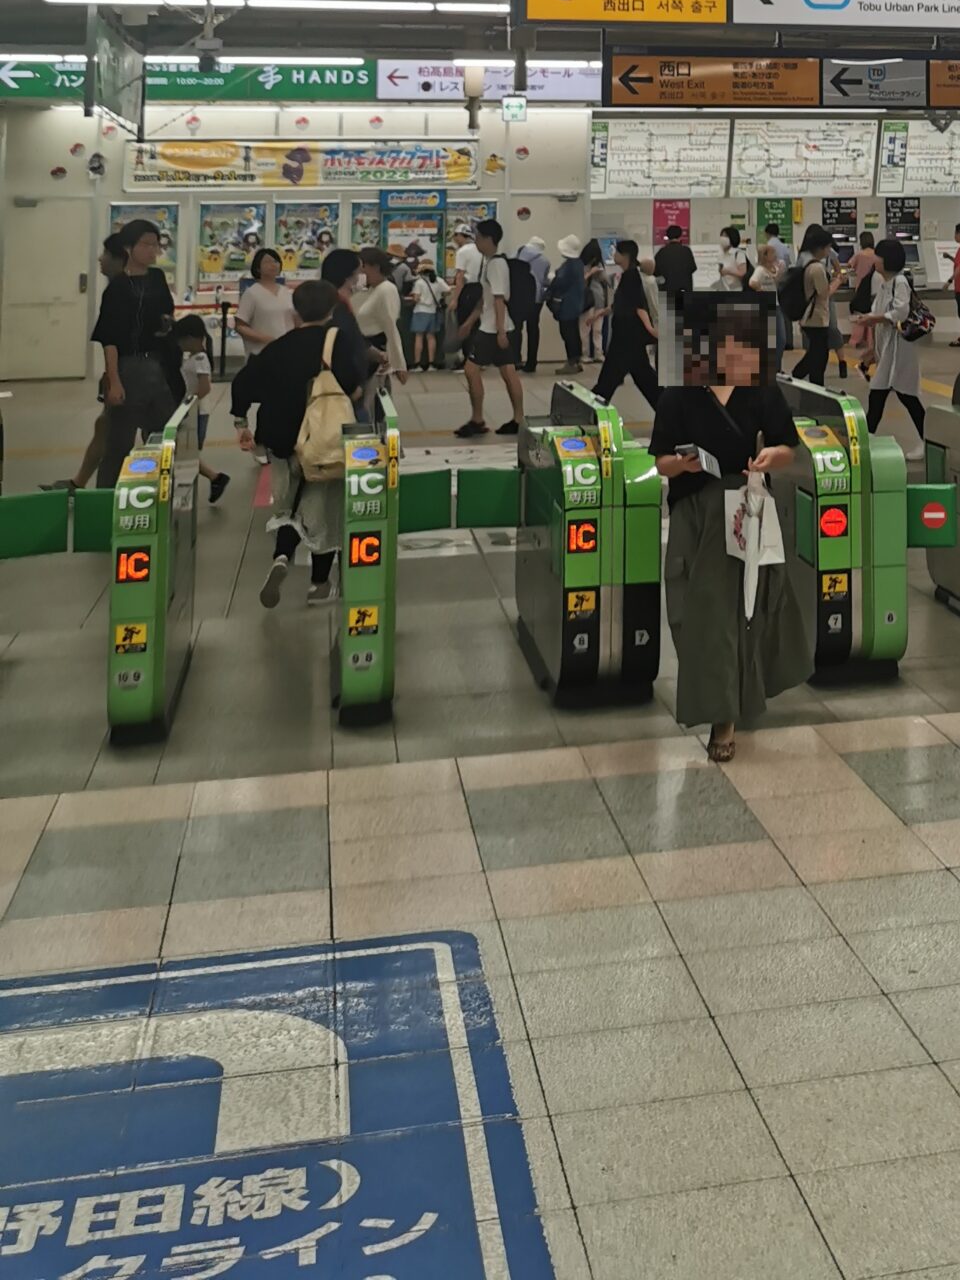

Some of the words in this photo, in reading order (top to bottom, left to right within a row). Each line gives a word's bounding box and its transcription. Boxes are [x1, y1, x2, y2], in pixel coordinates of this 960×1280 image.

[657, 0, 684, 13] 서쪽
[691, 0, 717, 14] 출구
[858, 1, 882, 13] Tobu
[885, 2, 914, 13] Urban
[917, 3, 939, 14] Park
[291, 70, 369, 84] HANDS
[659, 61, 691, 77] 西口
[659, 80, 684, 89] West
[687, 80, 705, 89] Exit
[358, 170, 412, 182] 2024
[815, 450, 846, 473] IC
[566, 462, 598, 486] IC
[349, 472, 384, 496] IC
[821, 477, 847, 491] 専用
[118, 485, 155, 510] IC
[568, 489, 597, 504] 専用
[352, 499, 381, 515] 専用
[119, 514, 149, 530] 専用
[569, 522, 596, 551] IC
[351, 536, 379, 564] IC
[119, 551, 149, 580] IC
